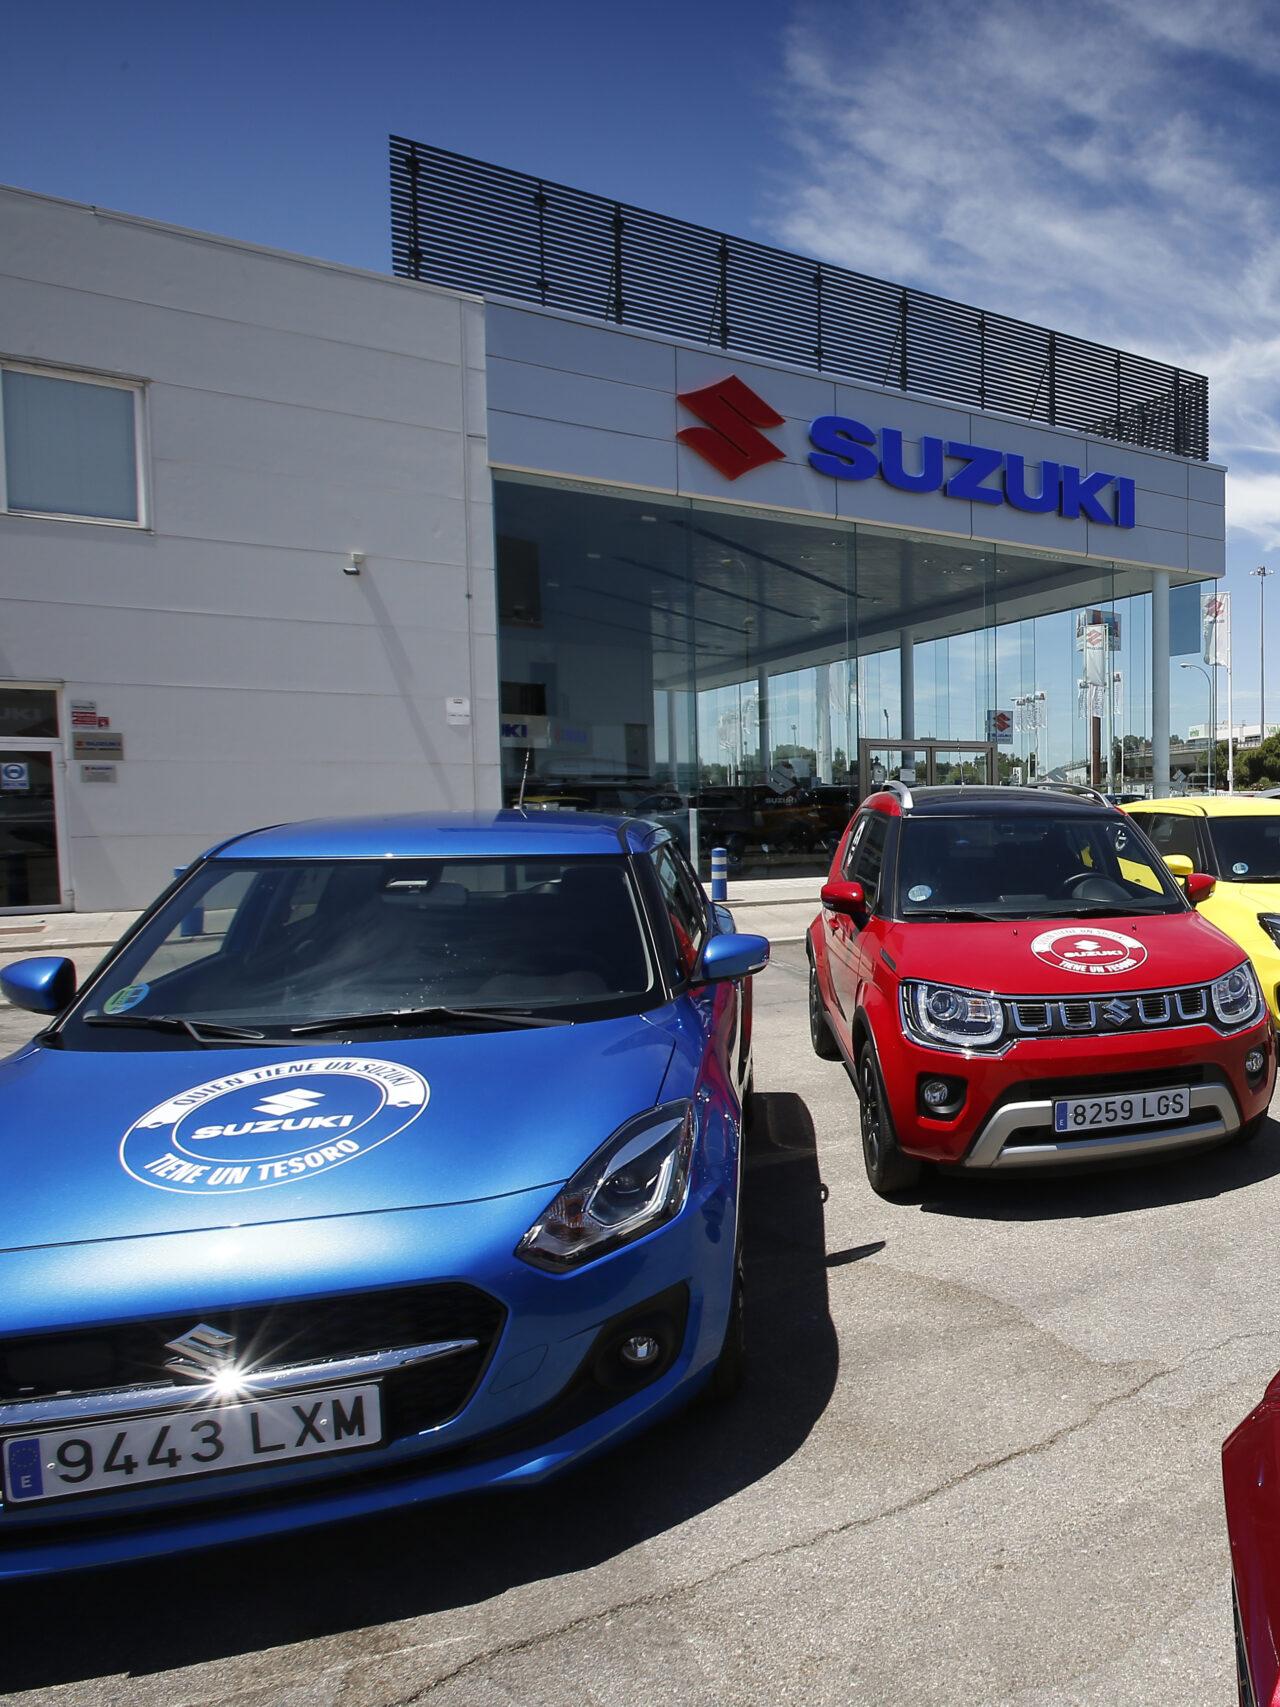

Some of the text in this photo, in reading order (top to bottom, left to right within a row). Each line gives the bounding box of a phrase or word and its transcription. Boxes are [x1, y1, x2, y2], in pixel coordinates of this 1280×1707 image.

[808, 415, 1136, 530] SUZUKI
[1063, 950, 1124, 958] SUZUKI
[173, 1061, 417, 1106] QUIEN TIENE UN SUZUKI
[191, 1114, 354, 1140] SUZUKI
[1073, 1099, 1134, 1126] 8259
[1142, 1093, 1184, 1119] LGS
[143, 1139, 361, 1186] TIENE UN TESORO
[20, 1395, 367, 1490] E 9443 LXM
